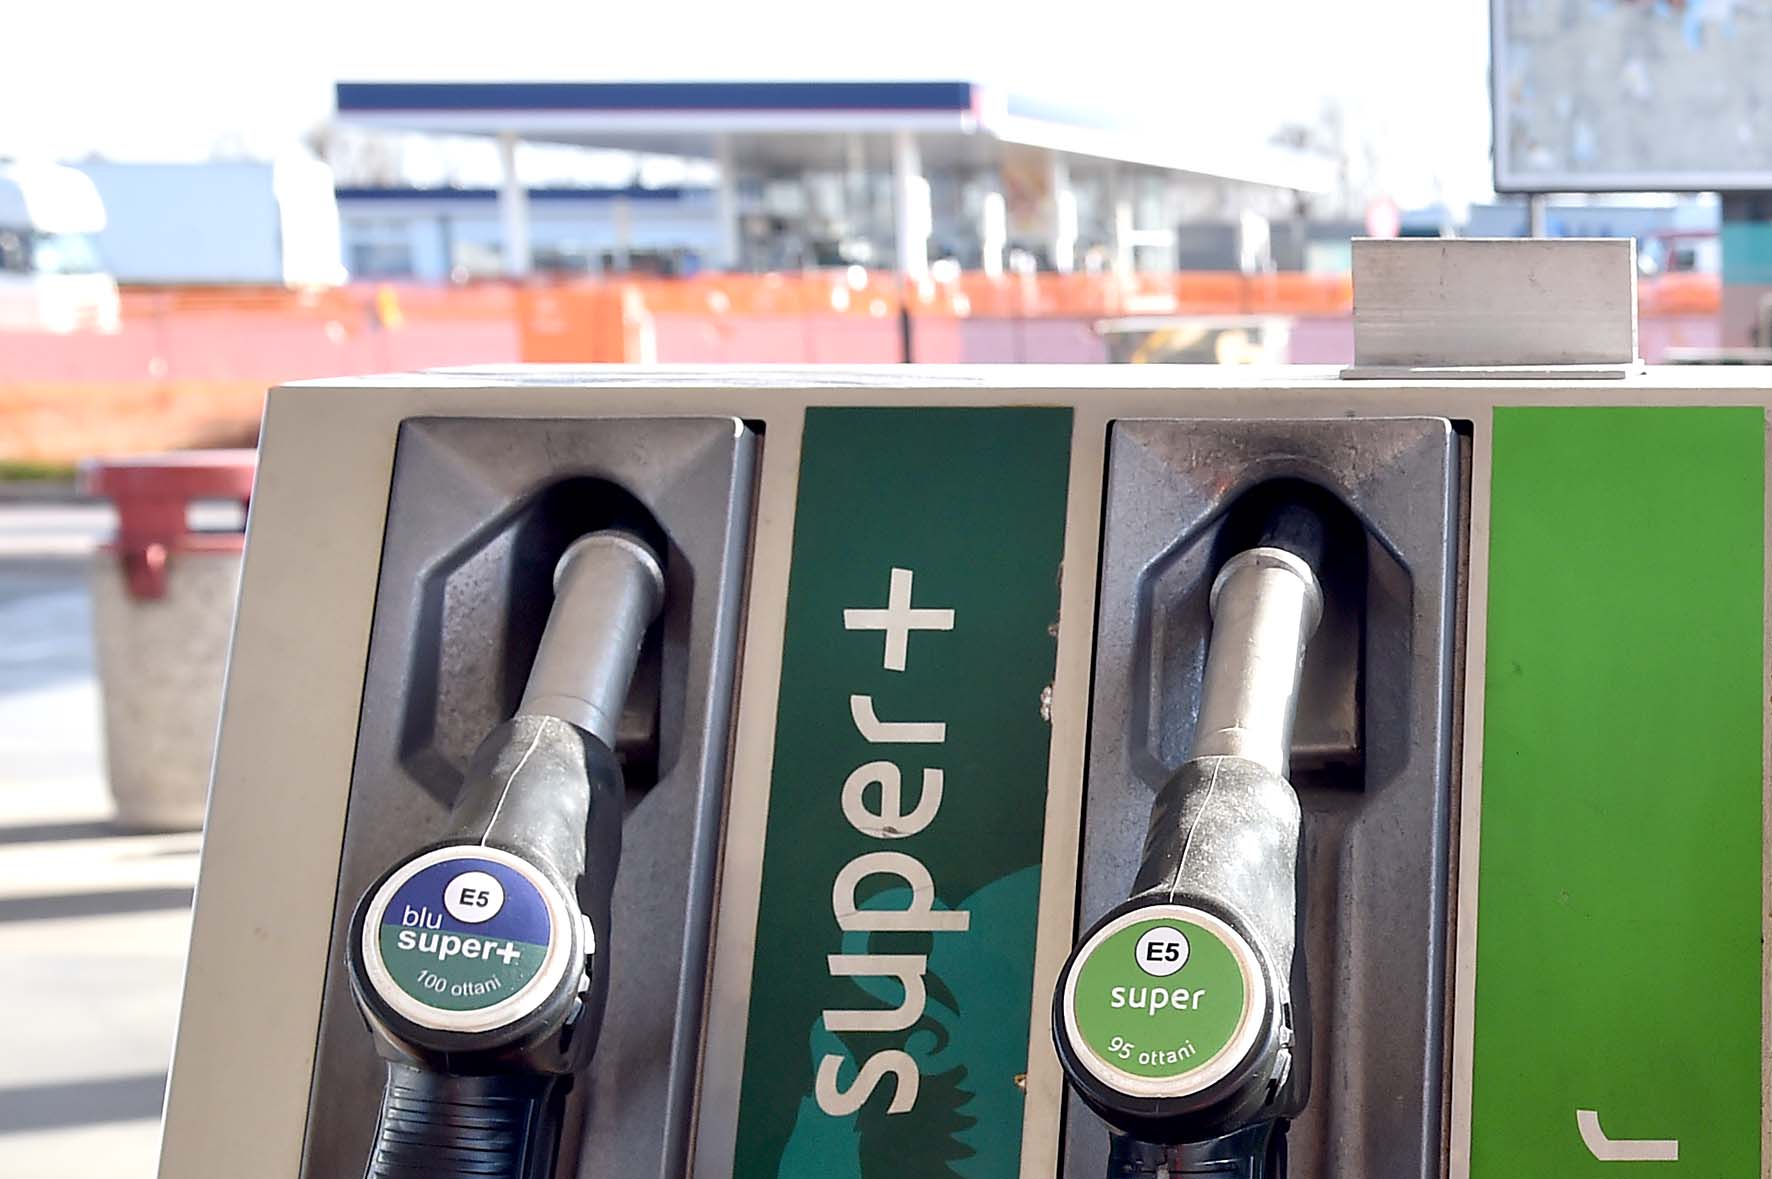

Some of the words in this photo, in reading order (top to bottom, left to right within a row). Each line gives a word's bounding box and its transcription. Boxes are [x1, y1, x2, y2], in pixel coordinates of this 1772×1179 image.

[815, 568, 970, 1115] super+
[459, 888, 490, 907] E5
[402, 905, 443, 929] blu
[397, 930, 521, 964] super+
[1146, 942, 1180, 962] E5
[417, 970, 447, 992] 100
[451, 975, 501, 997] ottani
[1111, 986, 1206, 1016] super
[1108, 1037, 1135, 1059] 95
[1139, 1040, 1197, 1066] ottani
